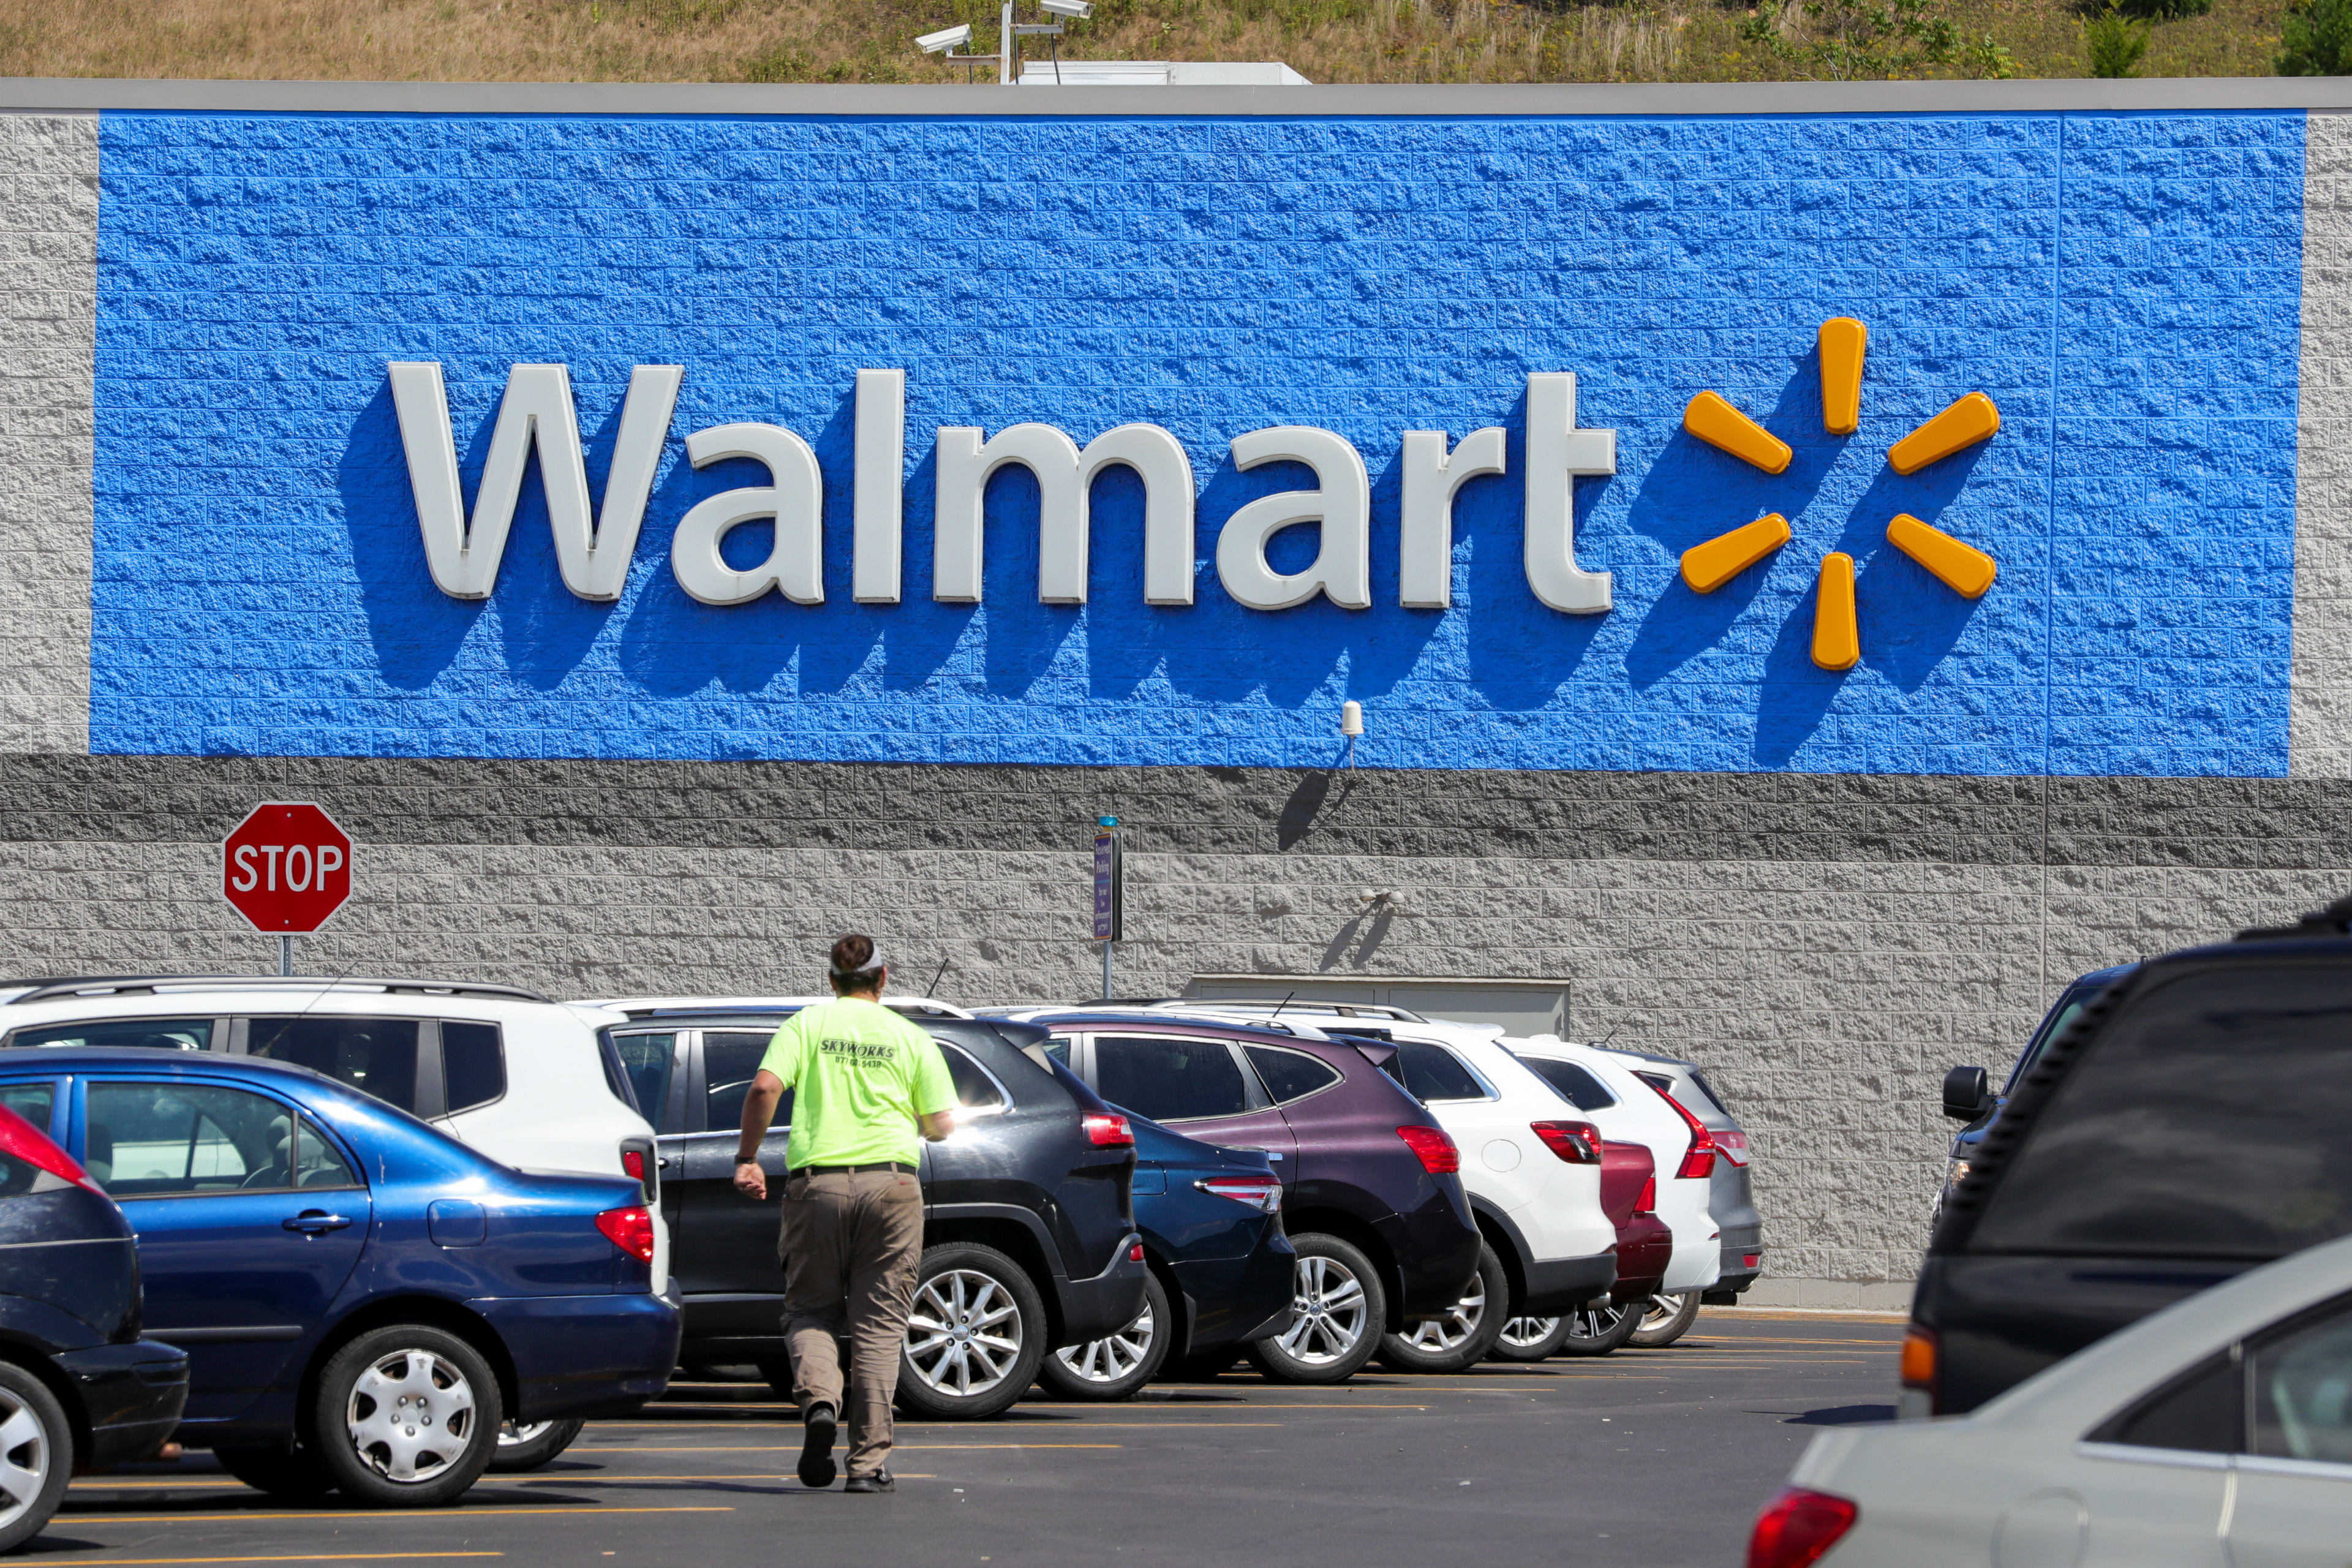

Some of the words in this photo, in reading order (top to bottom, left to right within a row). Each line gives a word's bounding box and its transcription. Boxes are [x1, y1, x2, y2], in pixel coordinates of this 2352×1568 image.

[387, 362, 1616, 614] Walmart
[232, 844, 343, 892] STOP
[1096, 861, 1109, 875] Parking
[820, 1039, 895, 1058] SKYWORKS
